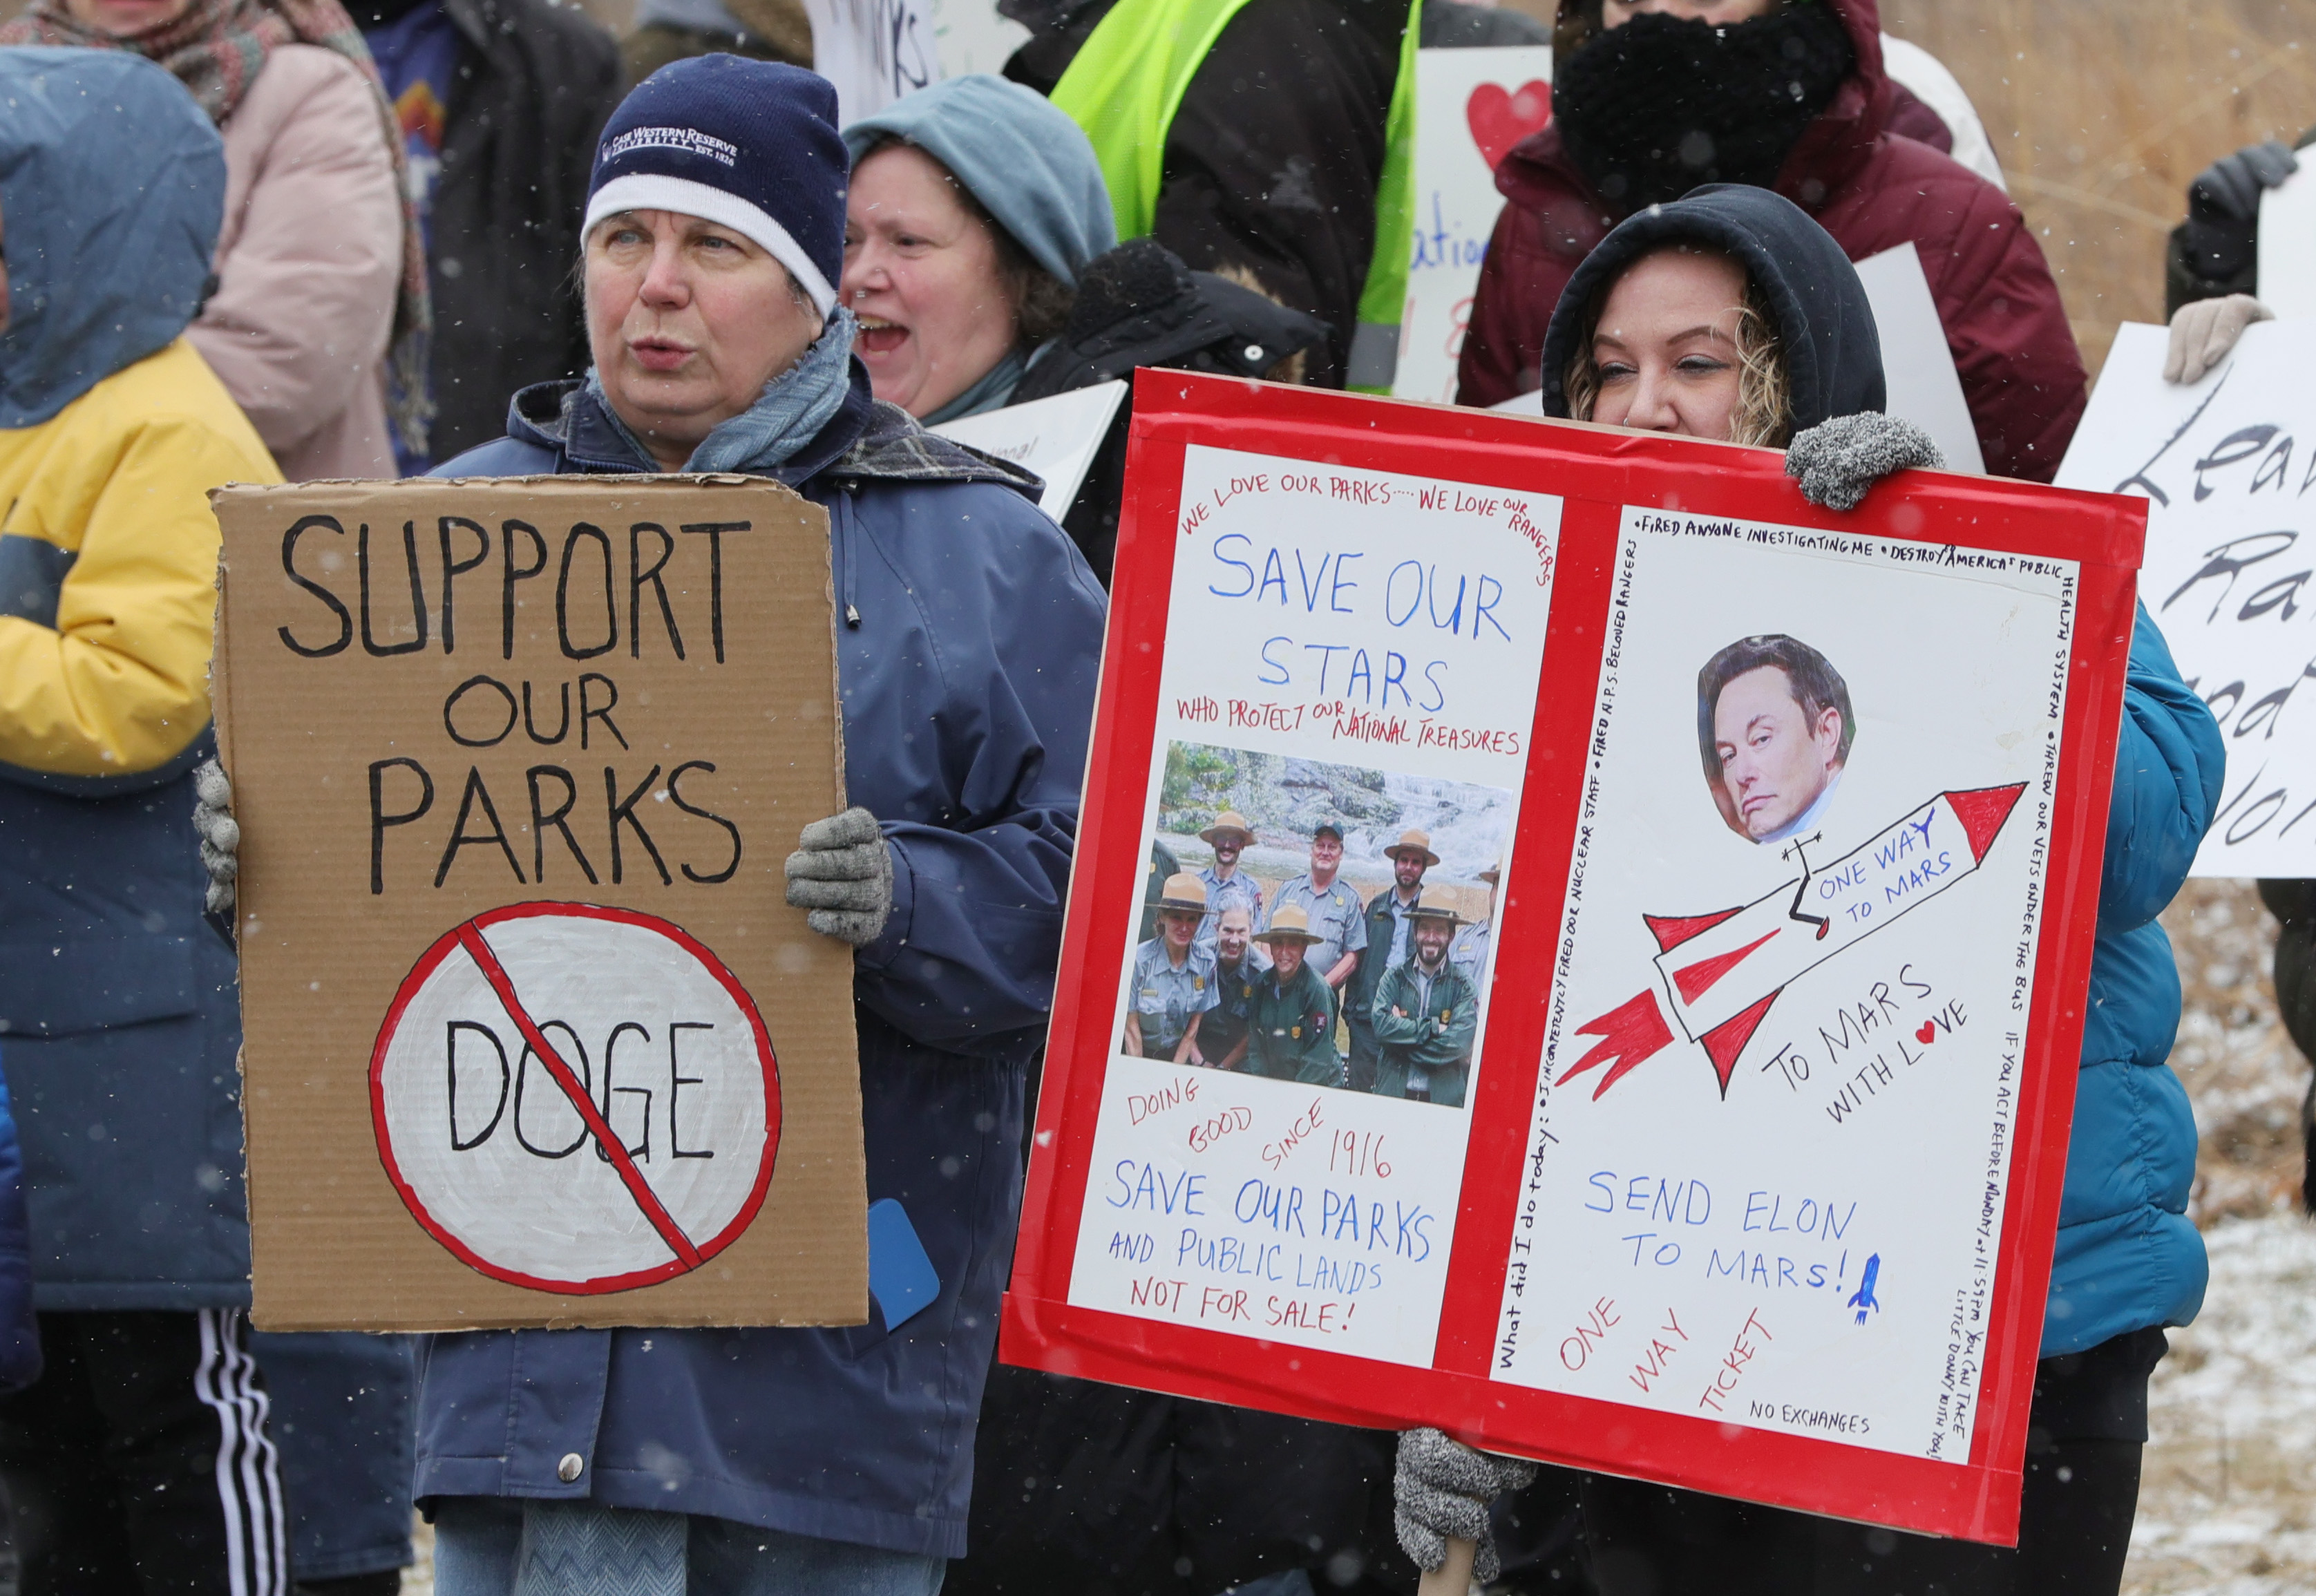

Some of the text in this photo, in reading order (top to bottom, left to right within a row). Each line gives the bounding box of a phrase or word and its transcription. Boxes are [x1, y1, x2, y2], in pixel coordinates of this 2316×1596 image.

[612, 126, 738, 157] CASE WESTERN RESERVE
[612, 136, 690, 153] UNIVERSITY
[694, 146, 734, 167] EST. 1826
[1214, 474, 1269, 506] LOVE
[1281, 475, 1322, 494] OUR
[1420, 485, 1448, 510] WE
[1454, 491, 1498, 516] LOVE
[1503, 498, 1528, 516] OUR
[1181, 503, 1209, 535] WE
[1642, 515, 1680, 536] FIRED
[1685, 520, 1741, 538] ANYONE
[1747, 529, 1848, 553] INVESTIGATING
[1852, 541, 1872, 556] ME
[1508, 514, 1553, 586] RANGERS
[1615, 540, 1636, 607] RANGERS
[278, 515, 752, 664] SUPPORT
[1209, 534, 1510, 641] SAVE OUR
[2058, 577, 2073, 640] HEALTH
[1606, 610, 1625, 668] BELOVED
[1258, 637, 1448, 716] STARS
[2048, 649, 2066, 719] SYSTEM
[444, 673, 628, 750] OUR
[1177, 696, 1519, 754] WHO PROTECT OUR NATIONAL TREASURES
[1593, 718, 1608, 757] FIRED
[2042, 743, 2057, 796] THREW
[1584, 775, 1600, 819] STAFF
[2036, 802, 2047, 831] OUR
[368, 758, 741, 895] PARKS
[1571, 826, 1593, 901] NUCLEAR
[1820, 806, 1935, 899] ONE WAY
[2030, 837, 2045, 877] VETS
[1846, 851, 1950, 922] TO MARS
[1559, 938, 1573, 977] FIRED
[2016, 941, 2030, 969] THE
[1761, 964, 1935, 1090] TO MARS
[2006, 1032, 2018, 1047] IF
[447, 1018, 716, 1162] DOGE
[1128, 1078, 1199, 1125] DOING
[1539, 1082, 1549, 1096] I
[1826, 1054, 1893, 1123] WITH
[1996, 1087, 2011, 1119] ACT
[1189, 1108, 1251, 1152] GOOD
[1262, 1098, 1323, 1170] SINCE
[1331, 1130, 1391, 1178] 1916
[1988, 1122, 2005, 1177] BEFORE
[1106, 1160, 1434, 1262] SAVE OUR PARKS
[1521, 1200, 1535, 1228] do
[1585, 1172, 1857, 1240] SEND ELON
[1109, 1228, 1380, 1294] AND PUBLIC LANDS
[1515, 1236, 1530, 1255] I
[1622, 1233, 1847, 1292] TO MARS!
[1131, 1276, 1355, 1333] NOT FOR SALE!
[1510, 1262, 1527, 1298] did
[1500, 1305, 1521, 1368] What
[1560, 1297, 1620, 1371] ONE
[1951, 1290, 1966, 1340] LITTLE
[1629, 1308, 1688, 1392] WAY
[1700, 1308, 1772, 1416] TICKET
[1942, 1344, 1960, 1391] DONNY
[1750, 1400, 1869, 1433] NO EXCHANGES
[1953, 1394, 1971, 1439] TAKE
